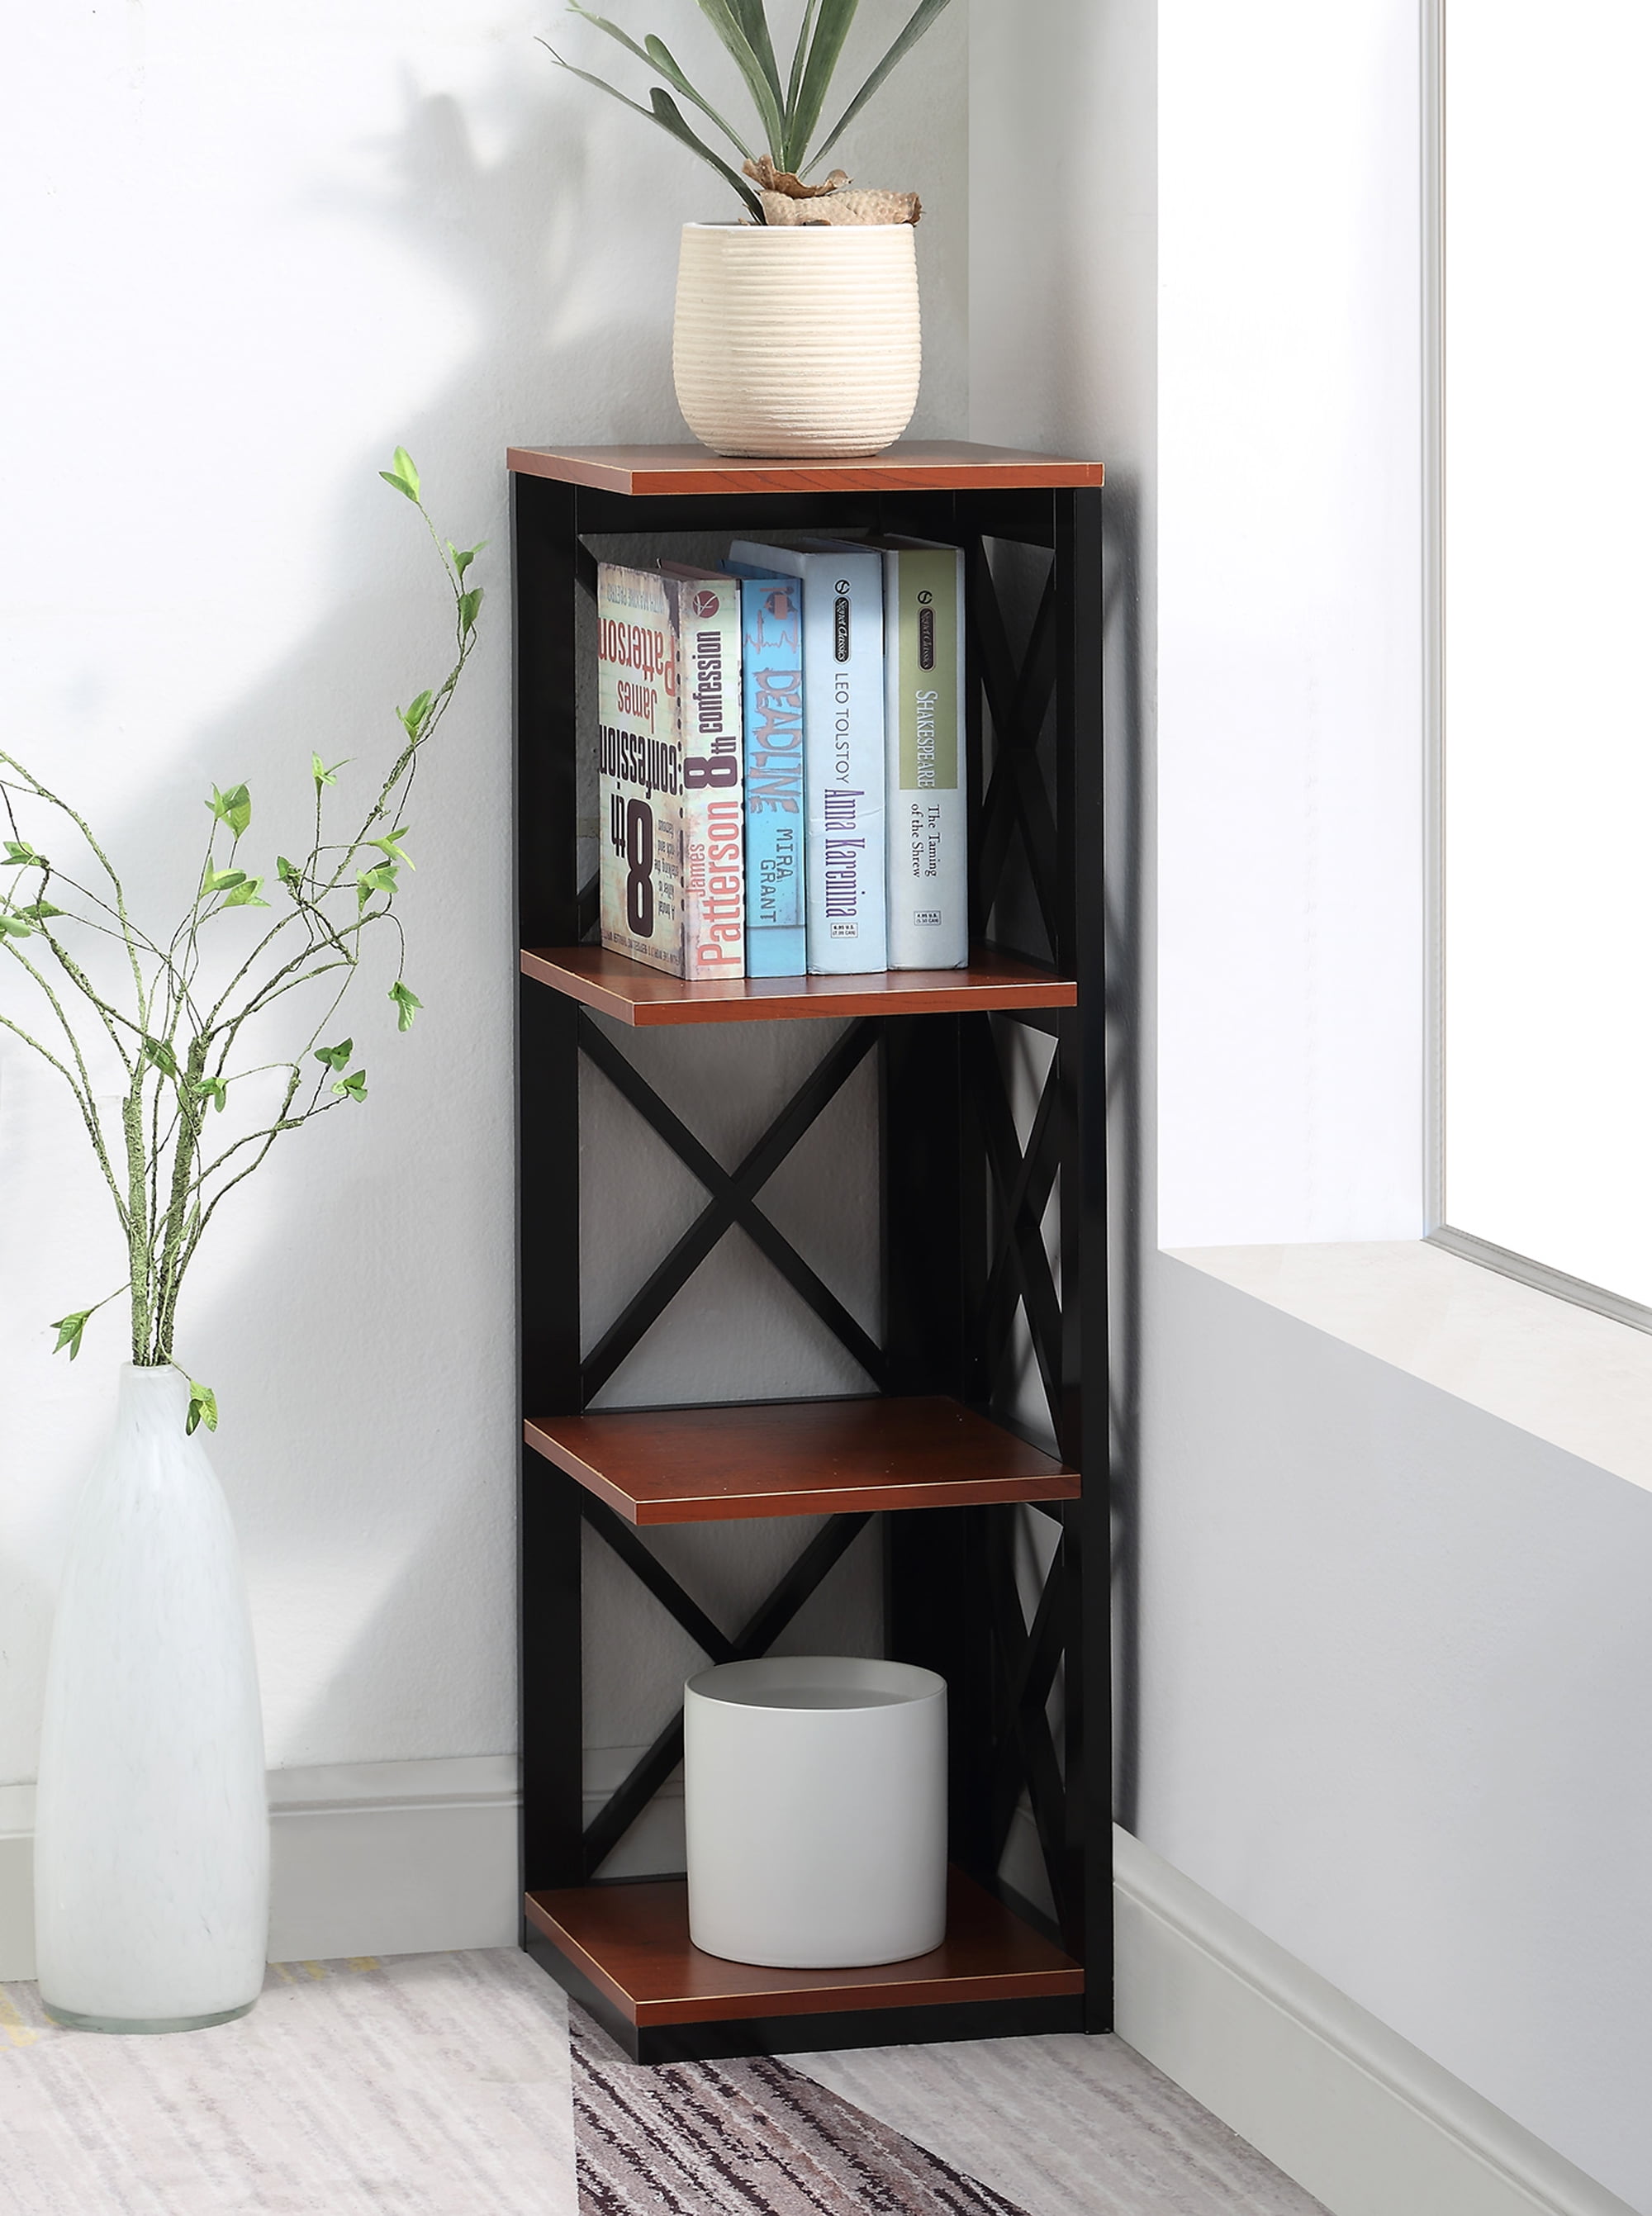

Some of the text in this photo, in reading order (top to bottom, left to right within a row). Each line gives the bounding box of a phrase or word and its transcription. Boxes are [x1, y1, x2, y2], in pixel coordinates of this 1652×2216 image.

[597, 617, 676, 697] Patterson
[617, 680, 657, 734] James
[683, 630, 738, 789] 8th confession
[749, 667, 802, 814] DEADLINE
[834, 673, 849, 784] LEO TOLSTOY
[915, 690, 938, 788] SHAKESPEARE
[598, 724, 677, 799] confession
[610, 792, 653, 938] 8th
[686, 843, 705, 897] James
[776, 828, 794, 880] MIRA
[824, 789, 866, 918] Anna Karenina
[910, 803, 924, 878] of the Shrew
[924, 804, 941, 877] The Taming
[697, 800, 742, 966] Patterson
[760, 859, 776, 923] GRANT
